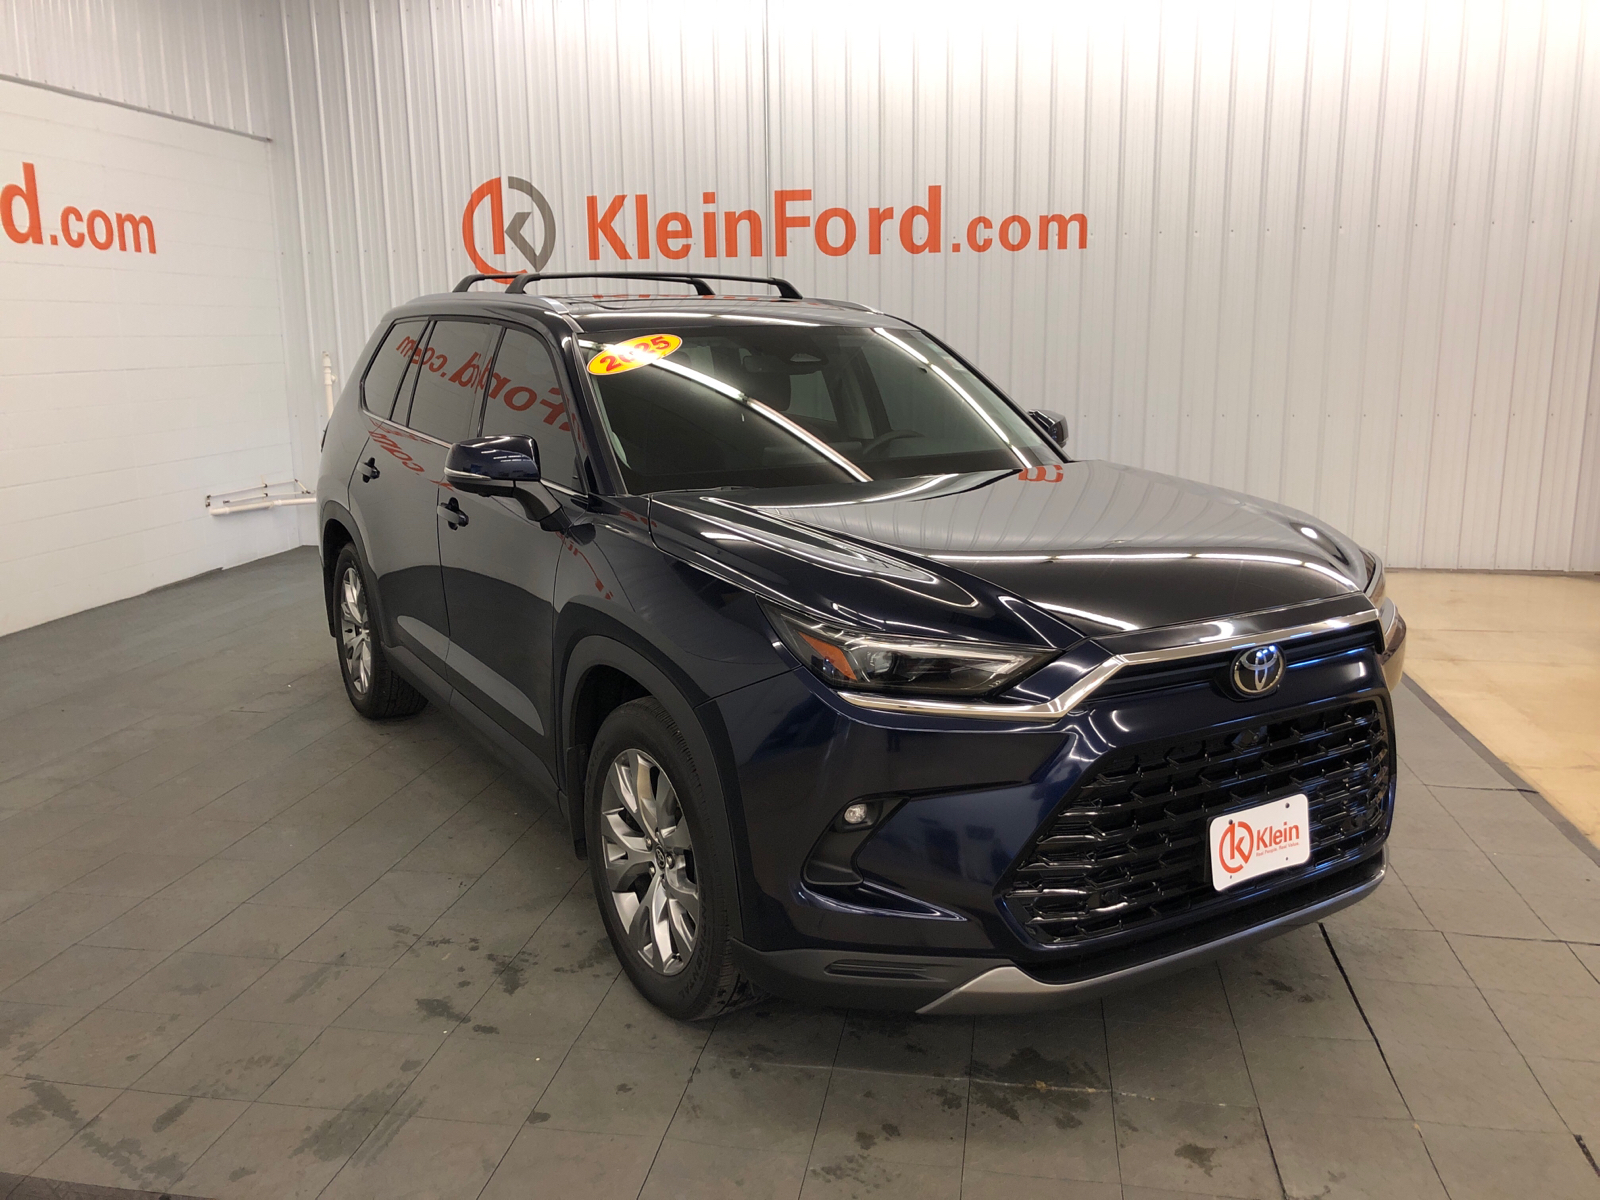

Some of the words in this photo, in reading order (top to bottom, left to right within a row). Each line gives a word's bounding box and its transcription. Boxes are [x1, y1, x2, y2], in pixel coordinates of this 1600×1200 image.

[0, 162, 157, 254] d.com
[586, 185, 1088, 260] KleinFord.com
[1256, 821, 1299, 851] Klein
